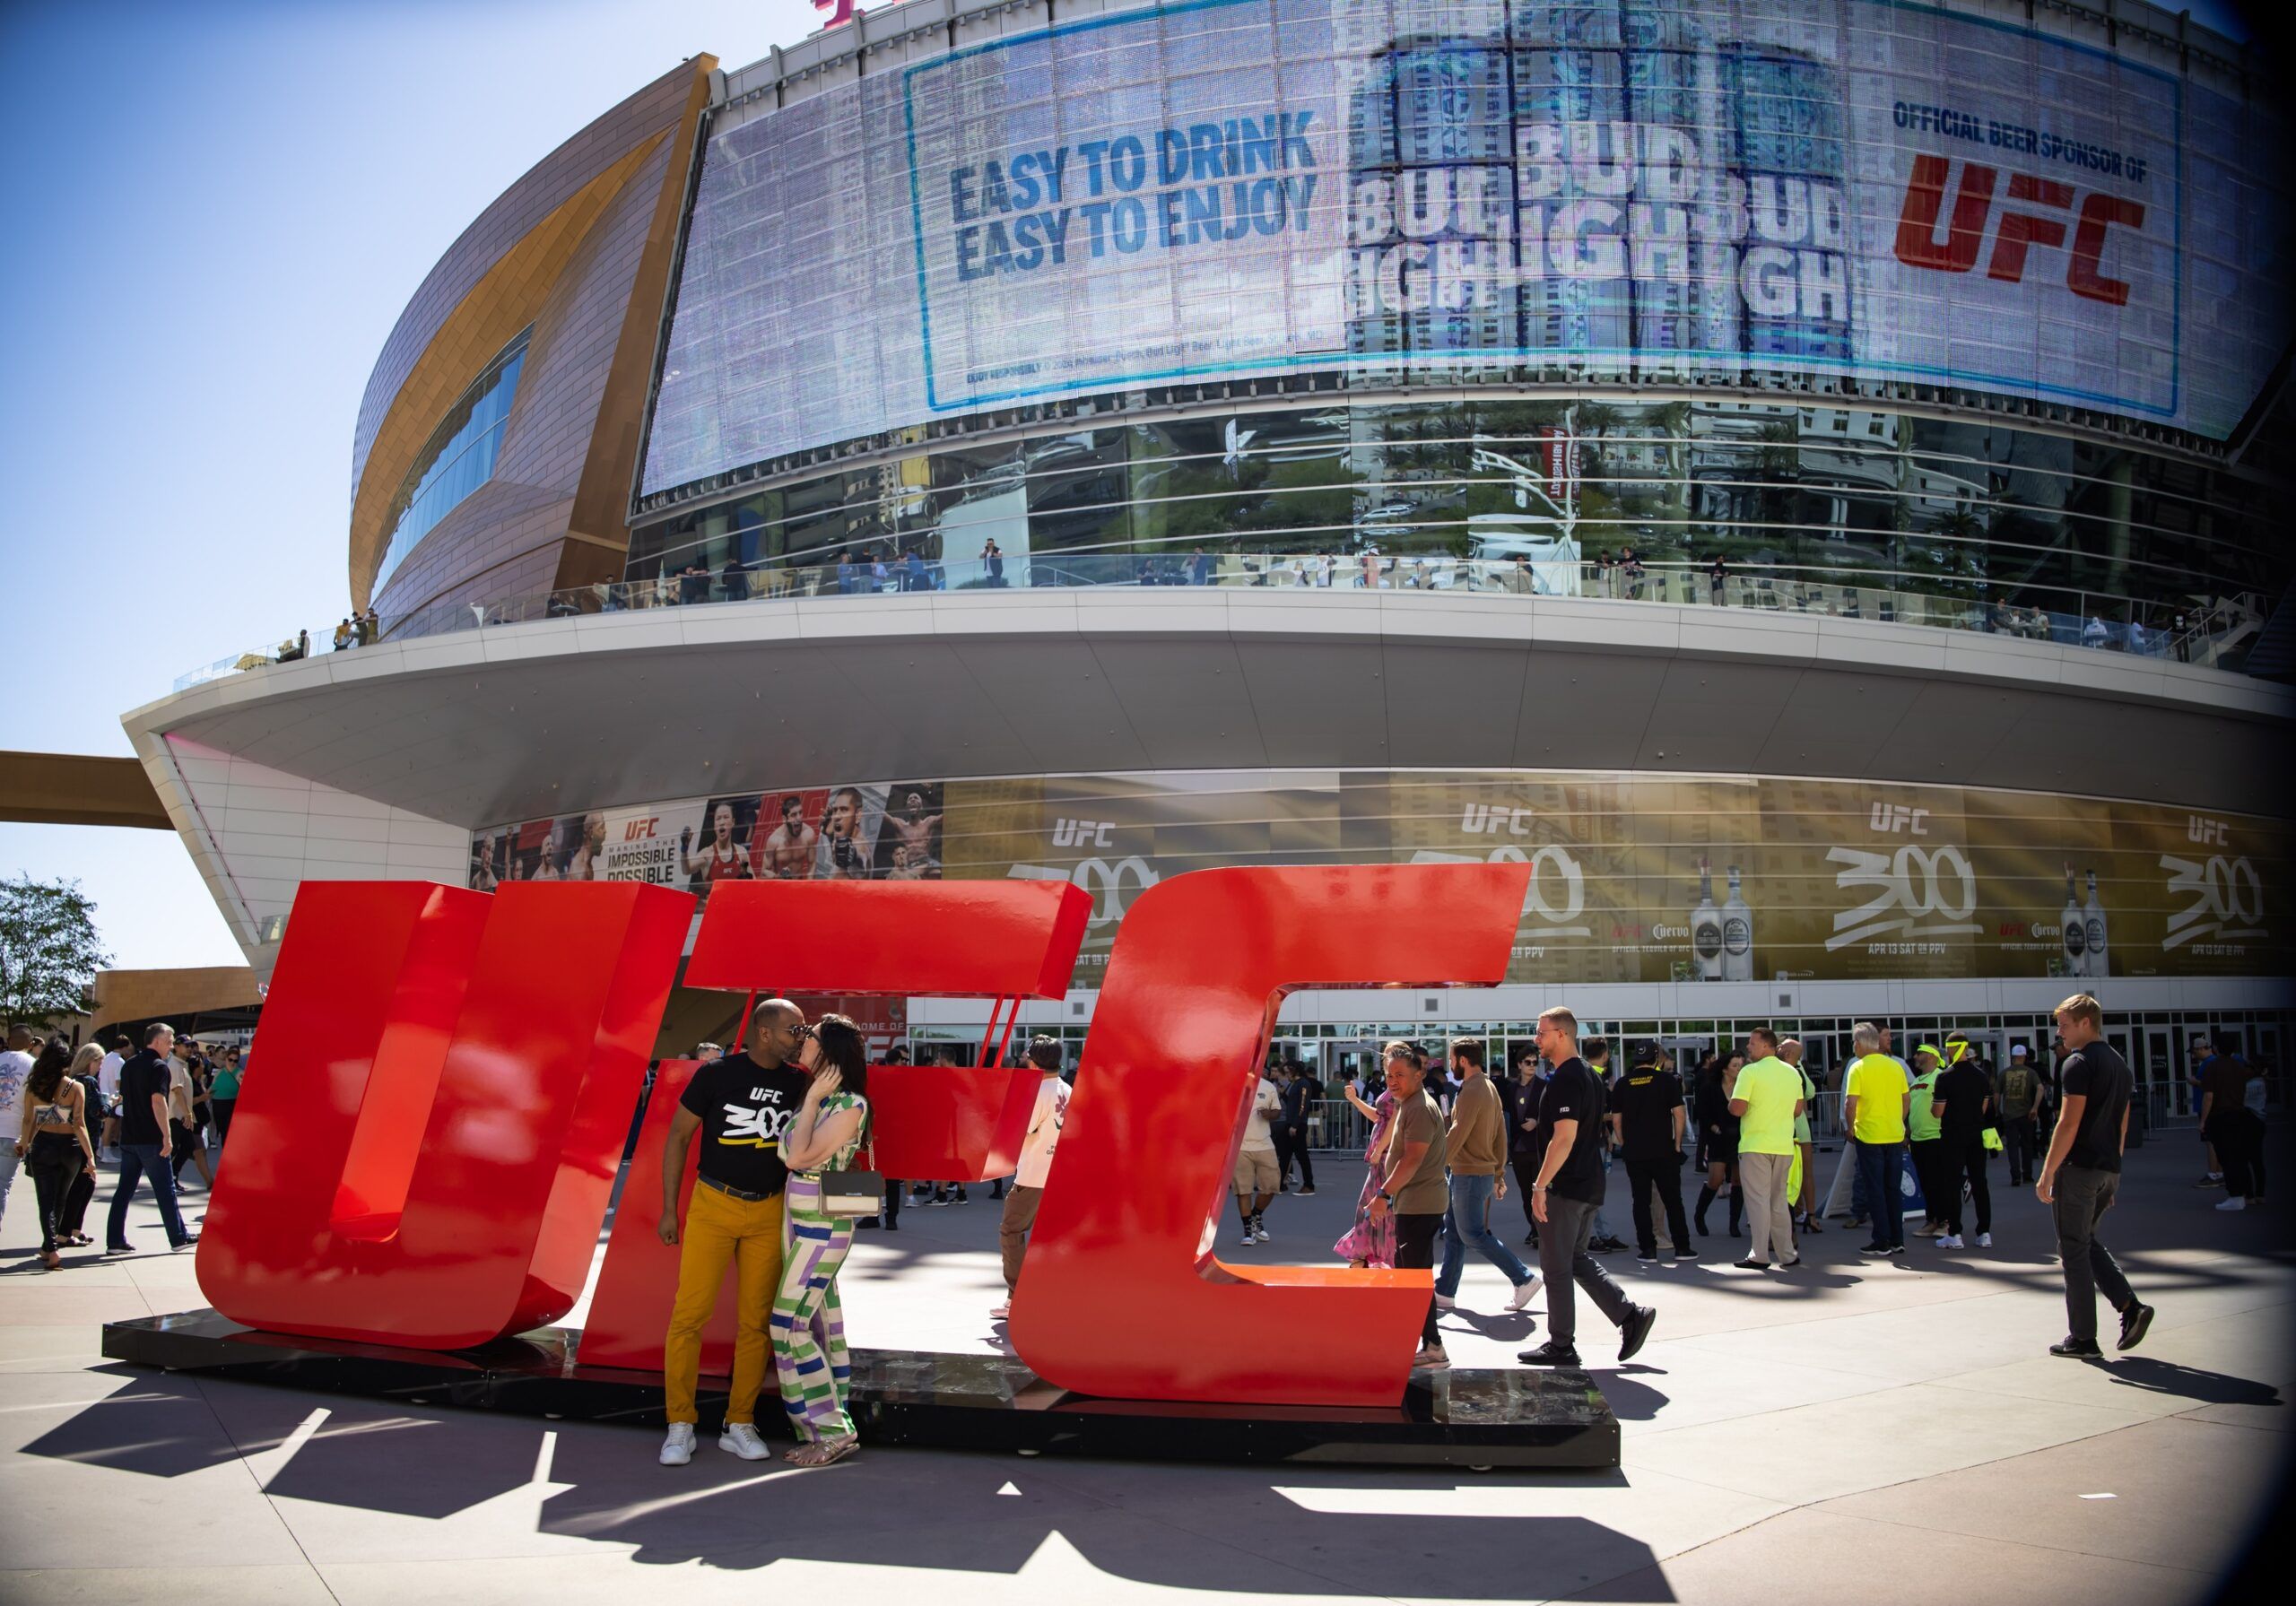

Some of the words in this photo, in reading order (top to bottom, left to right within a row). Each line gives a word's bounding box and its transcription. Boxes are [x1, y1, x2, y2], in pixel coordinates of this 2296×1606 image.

[1893, 100, 1986, 142] OFFICIAL
[1989, 120, 2038, 155] BEER
[2040, 132, 2122, 177] SPONSOR
[2126, 156, 2148, 183] OF
[951, 146, 1069, 223] EASY
[1078, 135, 1146, 195] TO
[1155, 109, 1315, 187] DRINK
[1517, 120, 1701, 199] BUD
[955, 208, 1072, 282] EASY
[1080, 196, 1148, 258] TO
[1159, 173, 1317, 248] ENJOY
[1893, 153, 2145, 307] UFC
[624, 817, 659, 842] UFC
[1052, 818, 1116, 847] UFC
[1461, 803, 1533, 835] UFC
[1870, 801, 1930, 836] UFC
[2188, 815, 2230, 846] UFC
[607, 847, 675, 869] IMPOSSIBLE
[609, 843, 648, 853] MAKING
[656, 838, 675, 847] THE
[1825, 844, 1978, 933] 300
[2159, 854, 2264, 933] 300
[1652, 924, 1689, 940] Cuervo
[1999, 922, 2026, 937] UFC
[2031, 922, 2060, 938] Cuervo
[1092, 954, 1102, 965] ON
[1511, 947, 1523, 959] ON
[1525, 946, 1544, 959] PPV
[1868, 943, 1886, 955] APR
[1888, 943, 1898, 955] 13
[1900, 943, 1917, 955] SAT
[1918, 944, 1927, 954] ON
[1929, 943, 1946, 955] PPV
[2192, 944, 2205, 956] APR
[2205, 944, 2213, 956] 13
[2213, 944, 2224, 956] SAT
[861, 1022, 885, 1031] OME
[890, 1022, 905, 1031] OF
[749, 1087, 783, 1104] UFC
[194, 861, 1533, 1408] UFC
